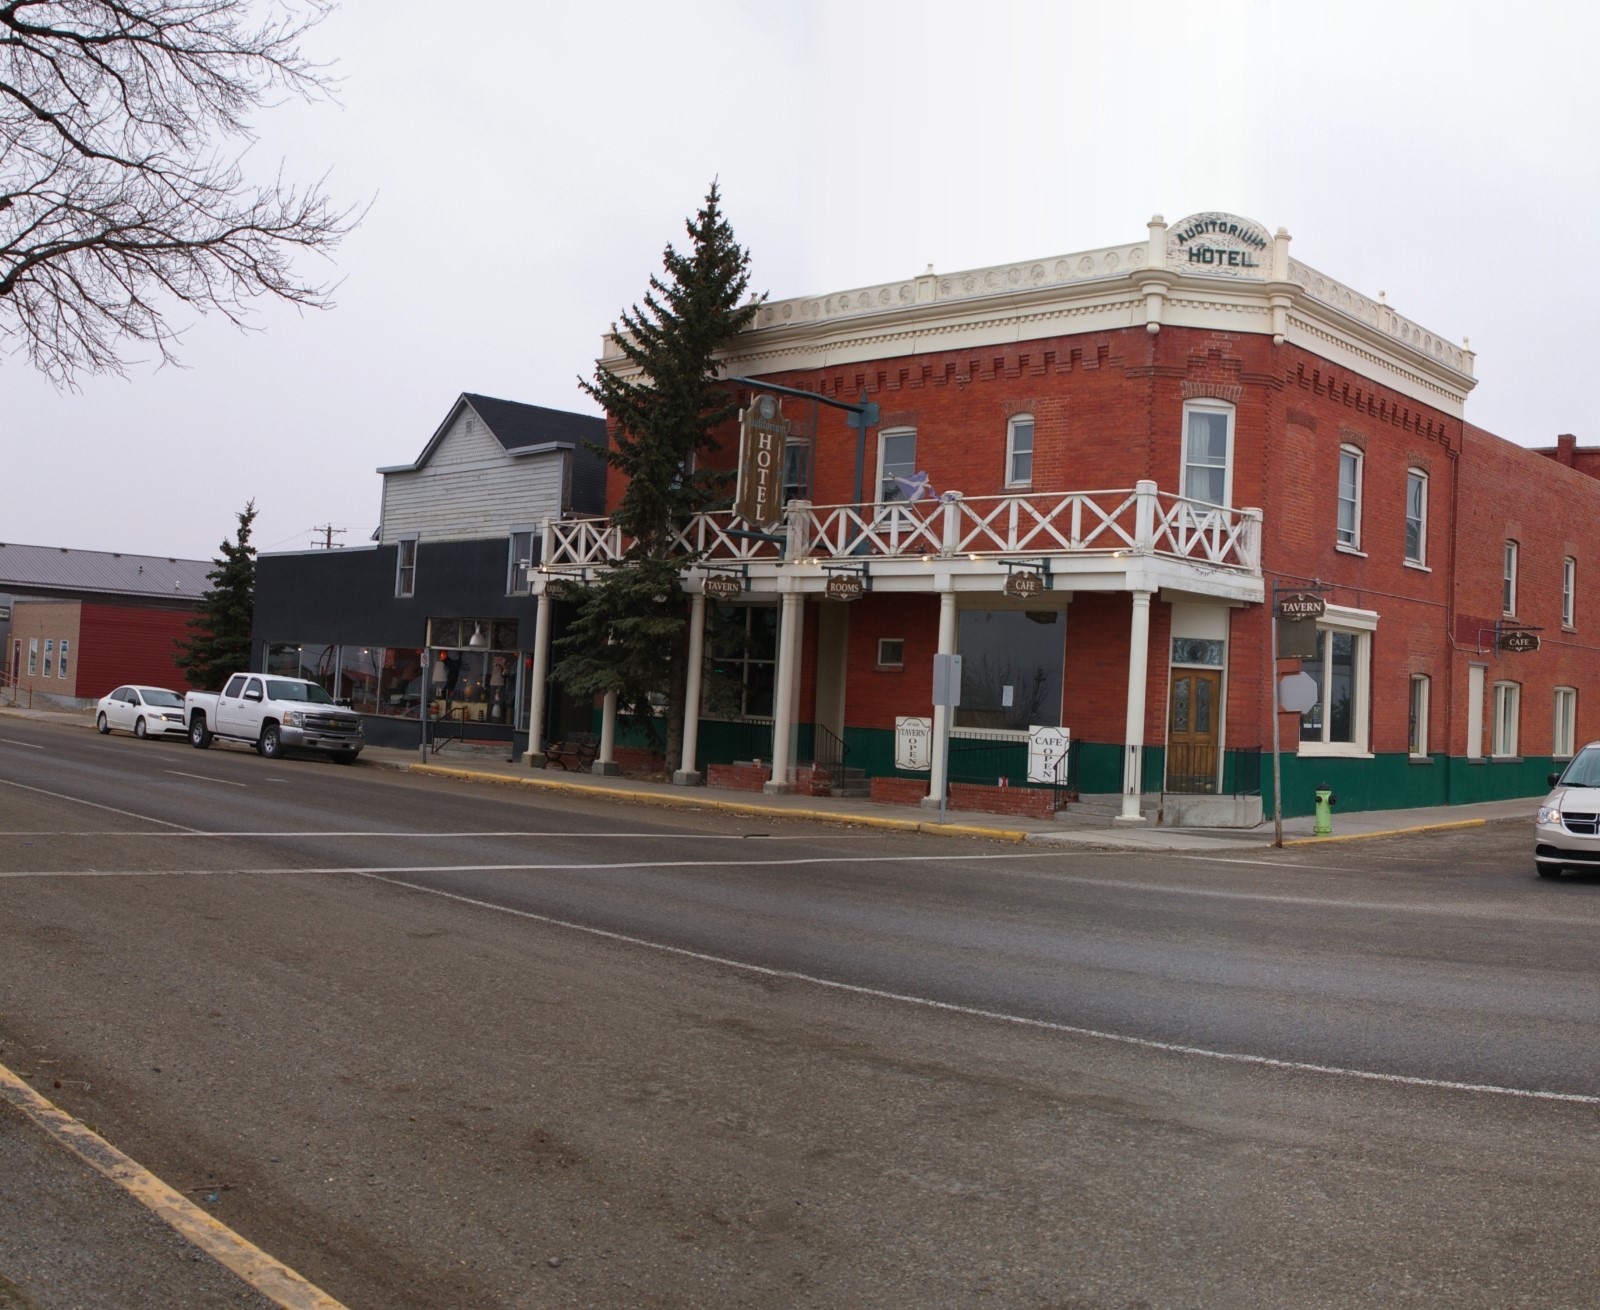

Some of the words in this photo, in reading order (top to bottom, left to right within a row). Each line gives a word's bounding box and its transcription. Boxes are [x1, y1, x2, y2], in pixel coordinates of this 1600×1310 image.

[1176, 220, 1267, 251] AUDITORIUM
[1189, 246, 1259, 268] HOTEL
[756, 432, 772, 521] HOTEL
[707, 581, 739, 592] TAVERN
[830, 582, 859, 593] ROOMS
[1015, 580, 1035, 590] CAFE
[1281, 602, 1322, 612] TAVERN
[1509, 638, 1529, 646] CAFE
[901, 728, 926, 737] TAVERN
[1035, 736, 1063, 746] CAFE
[908, 738, 917, 765] OPEN
[1043, 748, 1053, 778] OPEN
